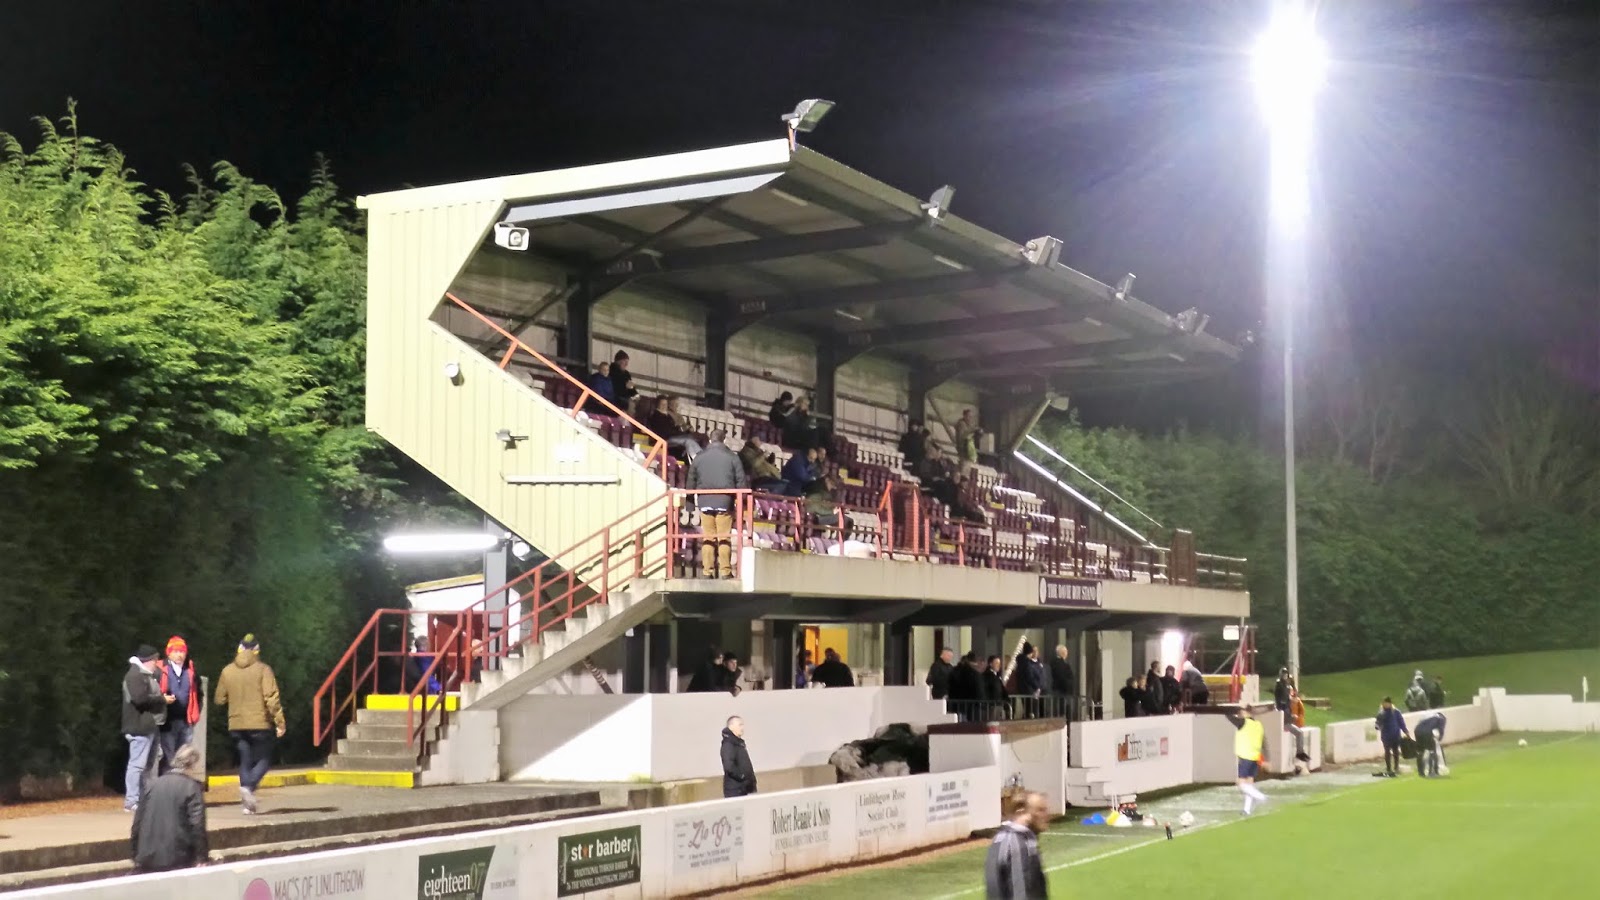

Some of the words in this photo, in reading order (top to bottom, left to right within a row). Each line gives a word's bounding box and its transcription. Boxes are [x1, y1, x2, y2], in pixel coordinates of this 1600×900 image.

[772, 807, 792, 834] Robert
[596, 836, 632, 857] barber
[274, 877, 300, 900] MAC'S
[301, 876, 314, 899] OF
[315, 869, 365, 896] LINLITHGOW
